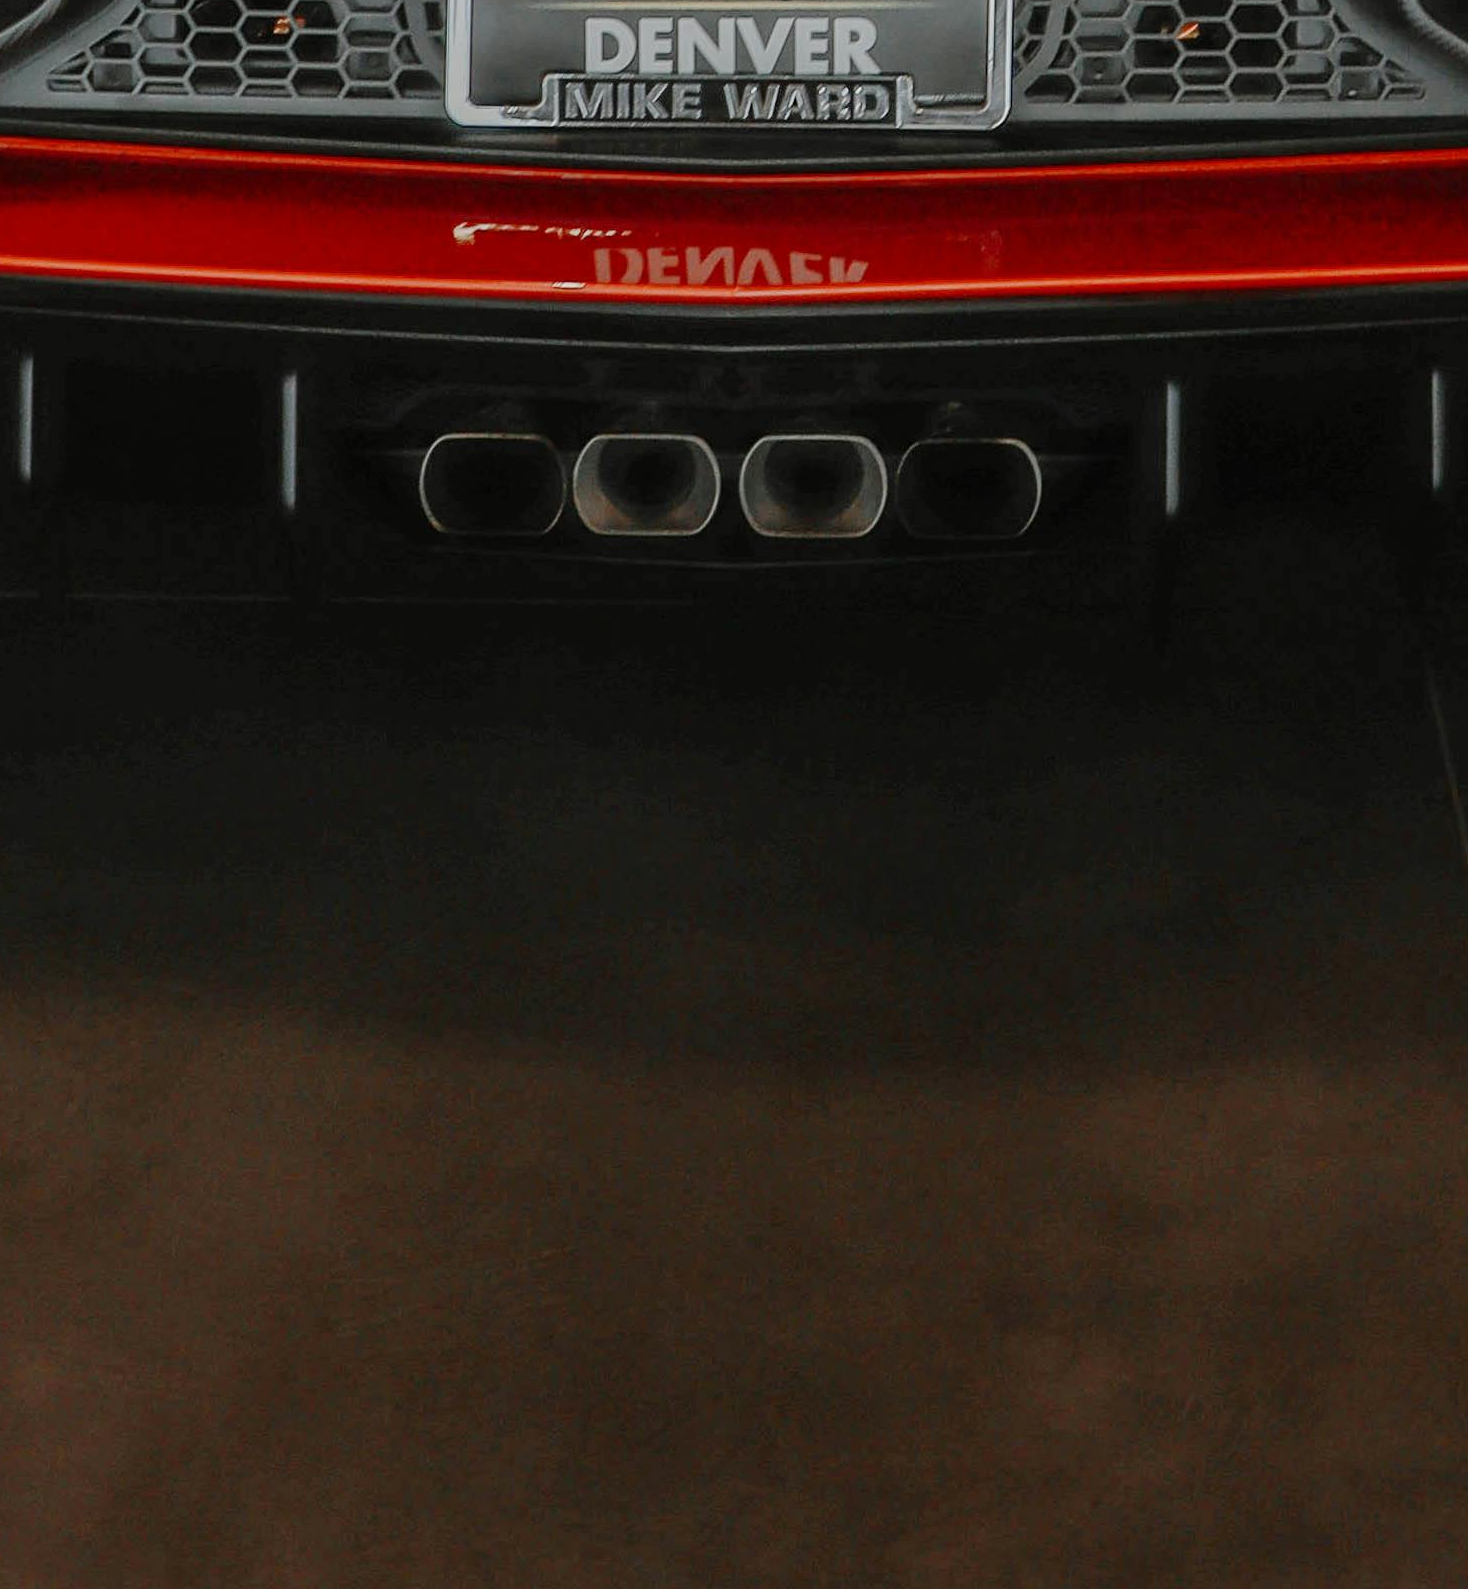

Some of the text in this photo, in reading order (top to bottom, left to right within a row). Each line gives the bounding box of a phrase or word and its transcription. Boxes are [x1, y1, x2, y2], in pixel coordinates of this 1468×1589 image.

[584, 17, 882, 75] DENVER
[564, 82, 891, 121] MIKE WARD
